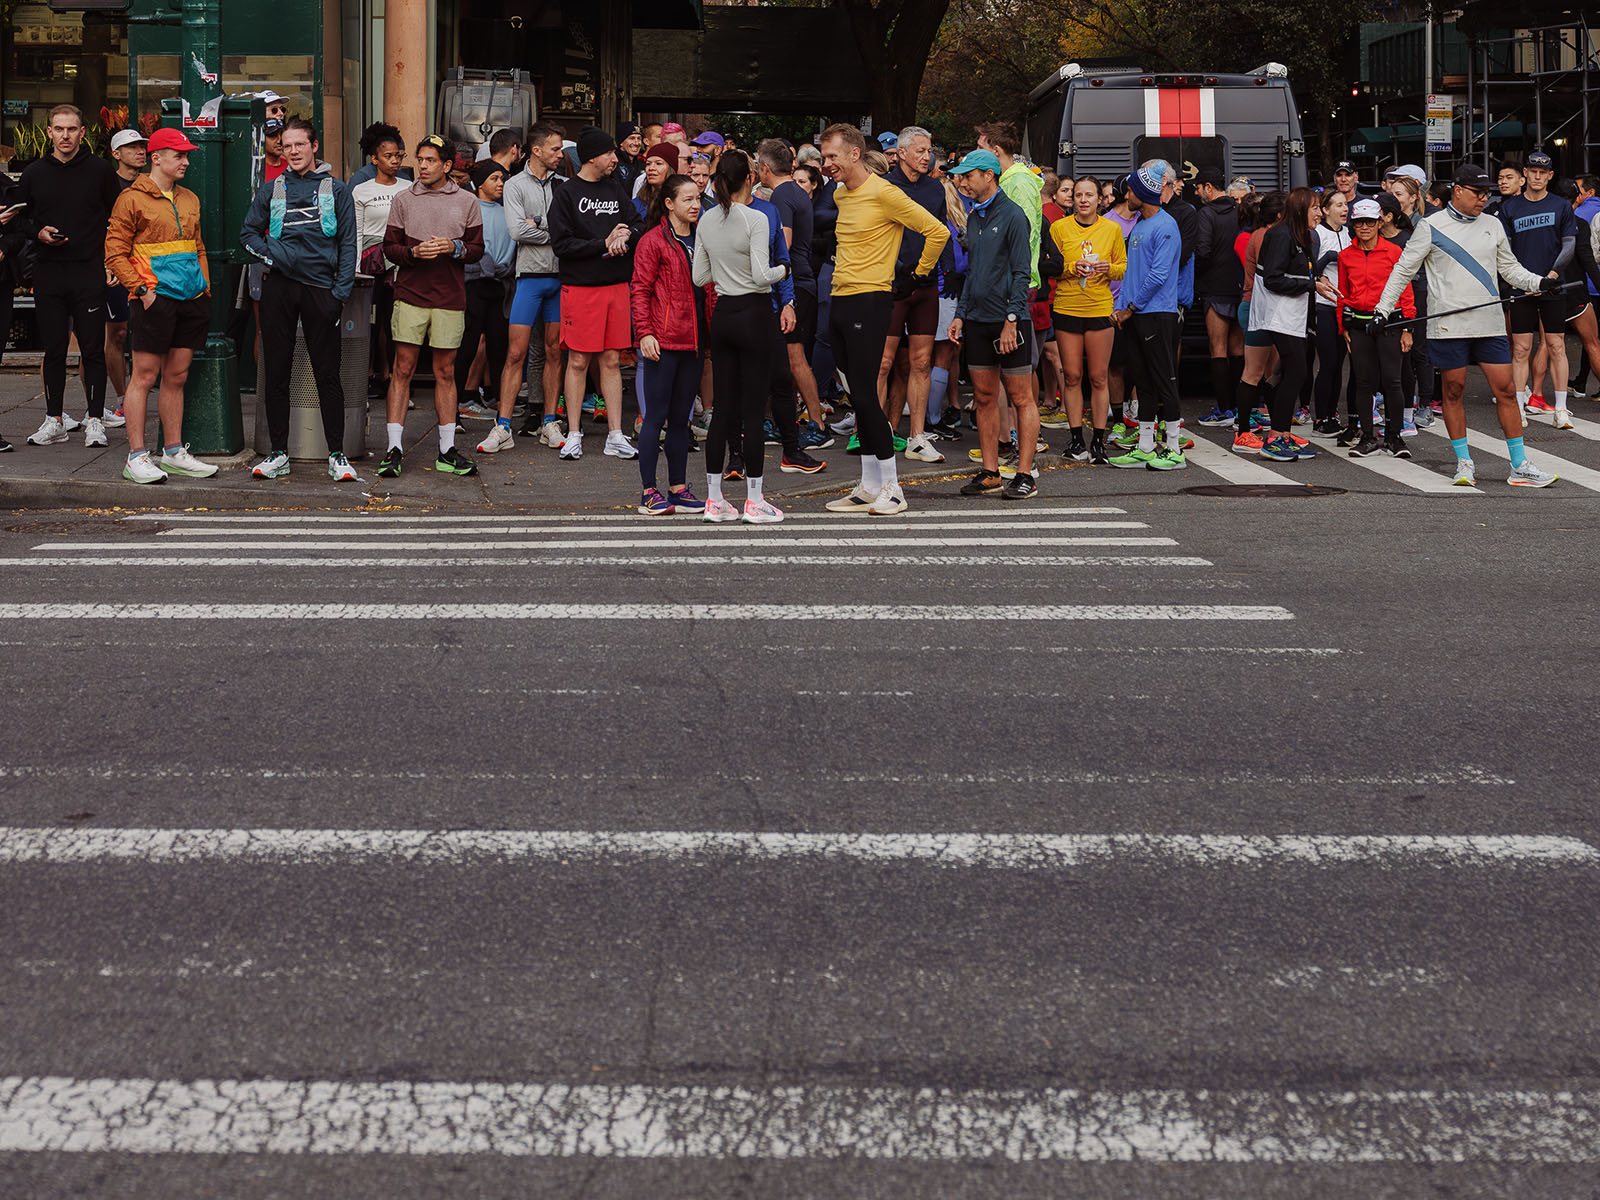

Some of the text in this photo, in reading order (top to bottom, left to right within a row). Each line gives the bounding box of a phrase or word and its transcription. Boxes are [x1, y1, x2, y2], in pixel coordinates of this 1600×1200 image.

[1429, 118, 1435, 126] 2
[1141, 173, 1157, 188] DASH
[578, 196, 620, 216] Chicago
[1518, 215, 1550, 229] HUNTER
